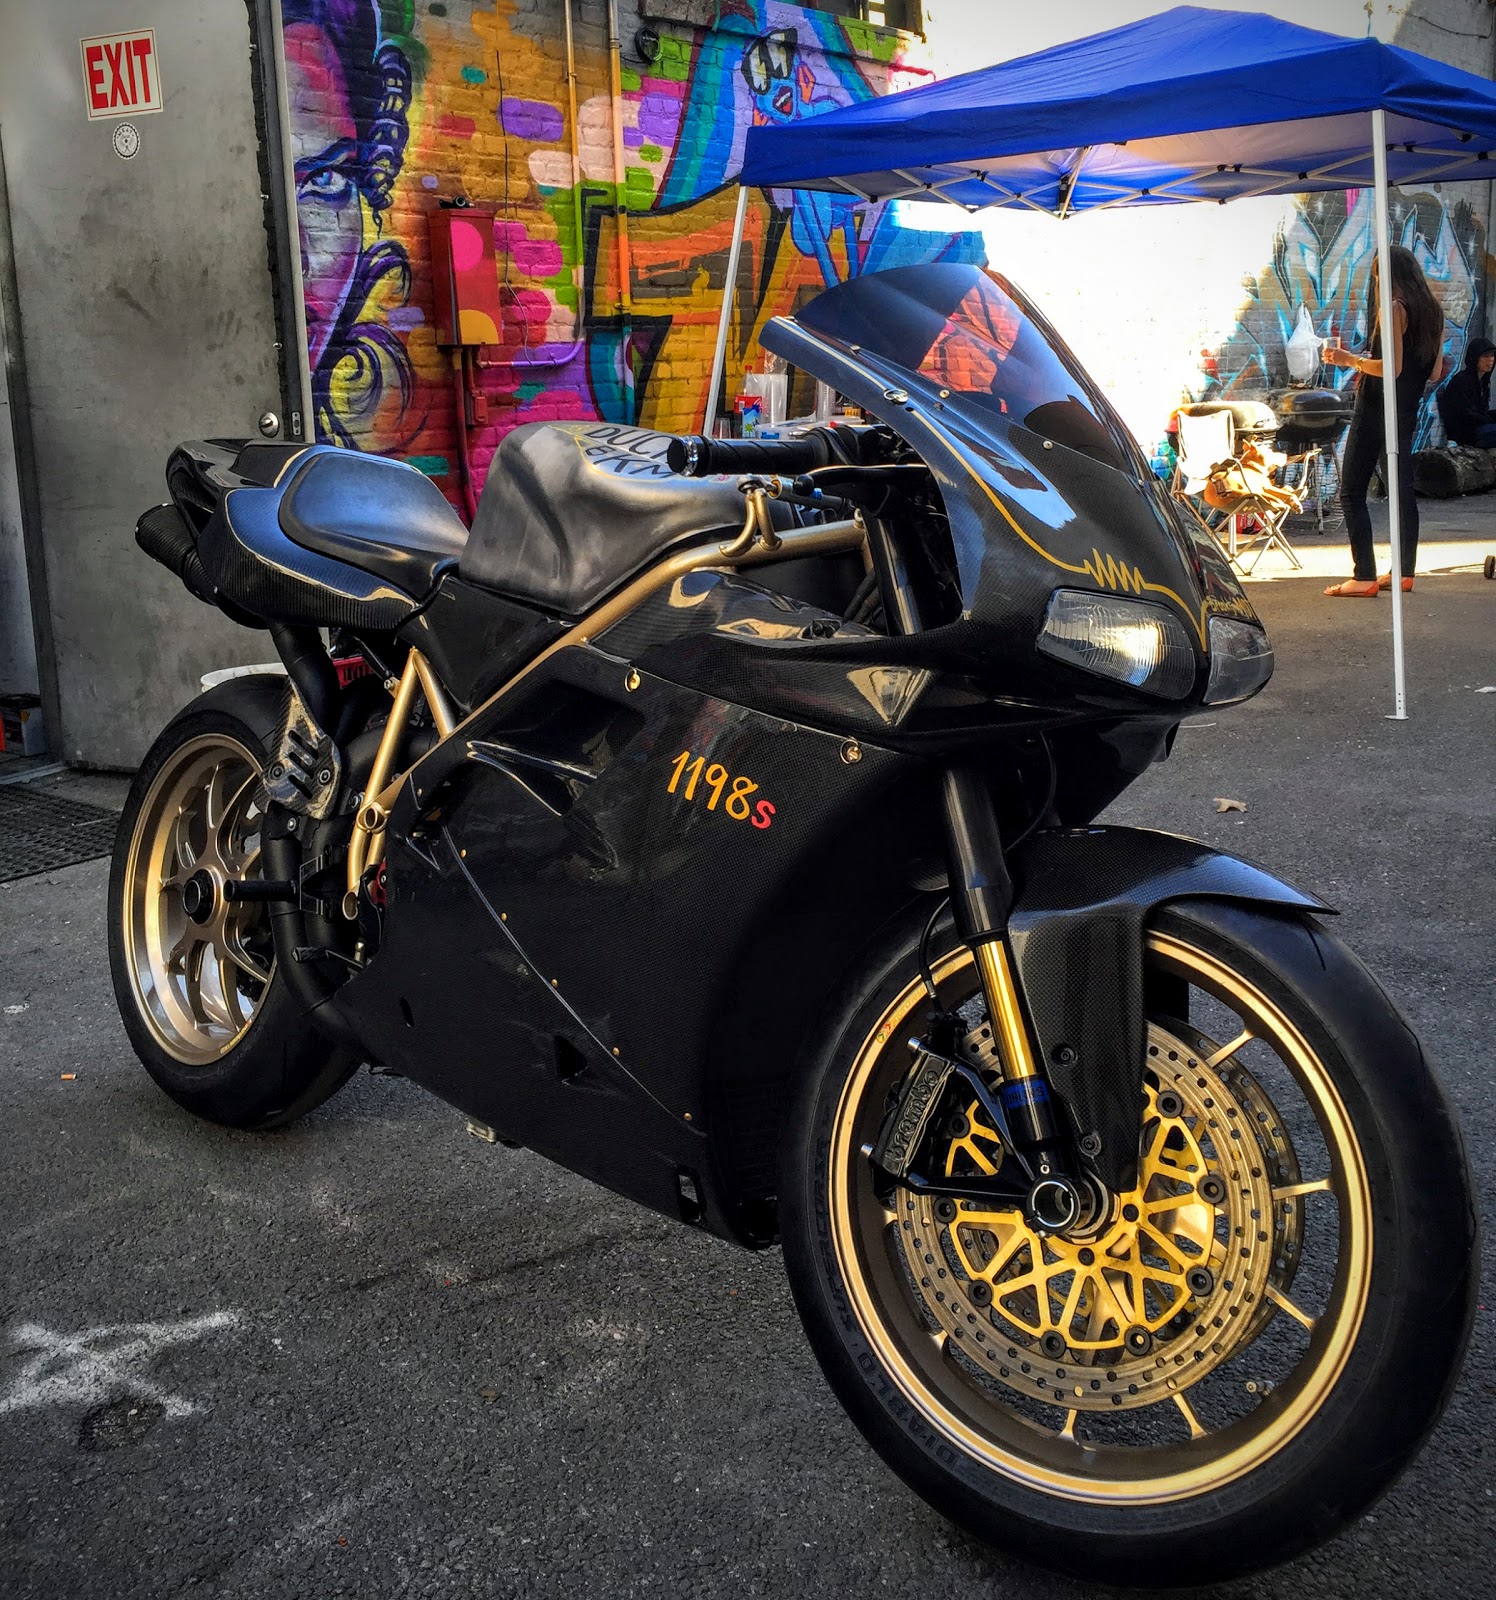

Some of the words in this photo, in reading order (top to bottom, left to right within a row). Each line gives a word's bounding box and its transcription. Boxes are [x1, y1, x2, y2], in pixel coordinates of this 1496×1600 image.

[86, 39, 152, 109] EXIT
[885, 1070, 938, 1161] brembo
[858, 1352, 957, 1466] DIABLO
